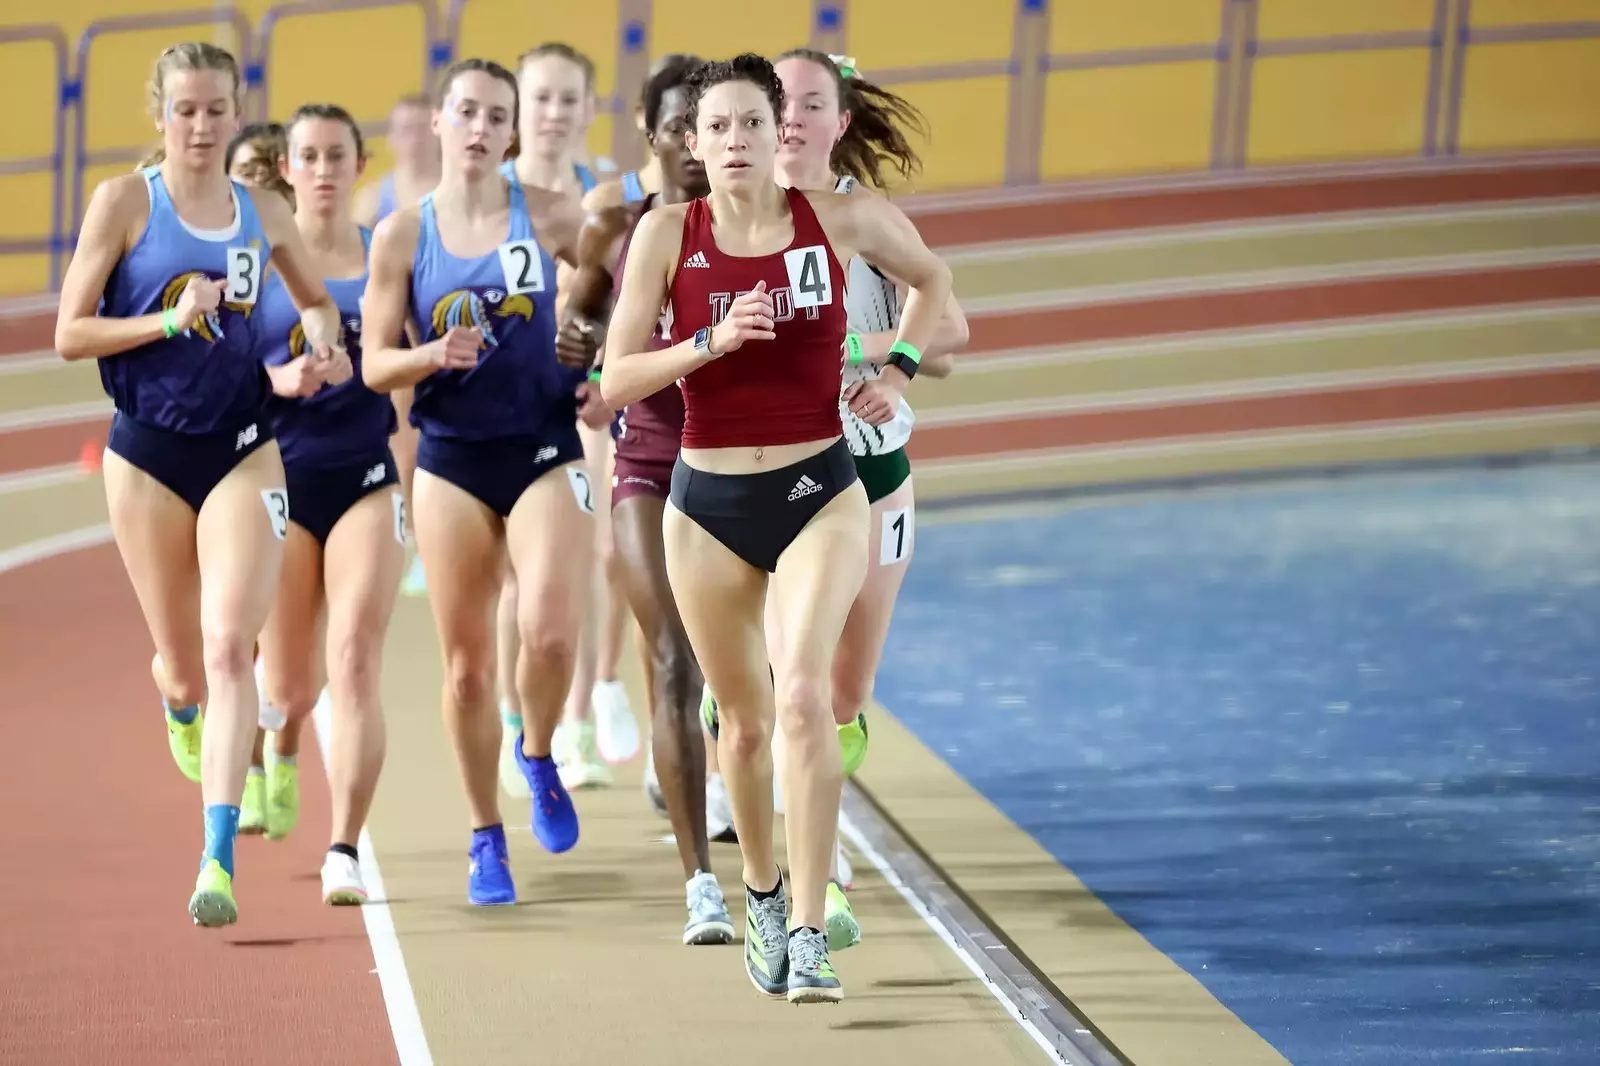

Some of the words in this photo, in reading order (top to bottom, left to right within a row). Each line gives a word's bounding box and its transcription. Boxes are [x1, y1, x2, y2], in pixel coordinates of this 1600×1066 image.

[234, 252, 254, 299] 3
[510, 245, 538, 289] 2
[799, 251, 826, 302] 4
[709, 286, 820, 327] TO
[270, 492, 288, 537] 3
[787, 483, 823, 501] adidas
[892, 512, 905, 559] 1
